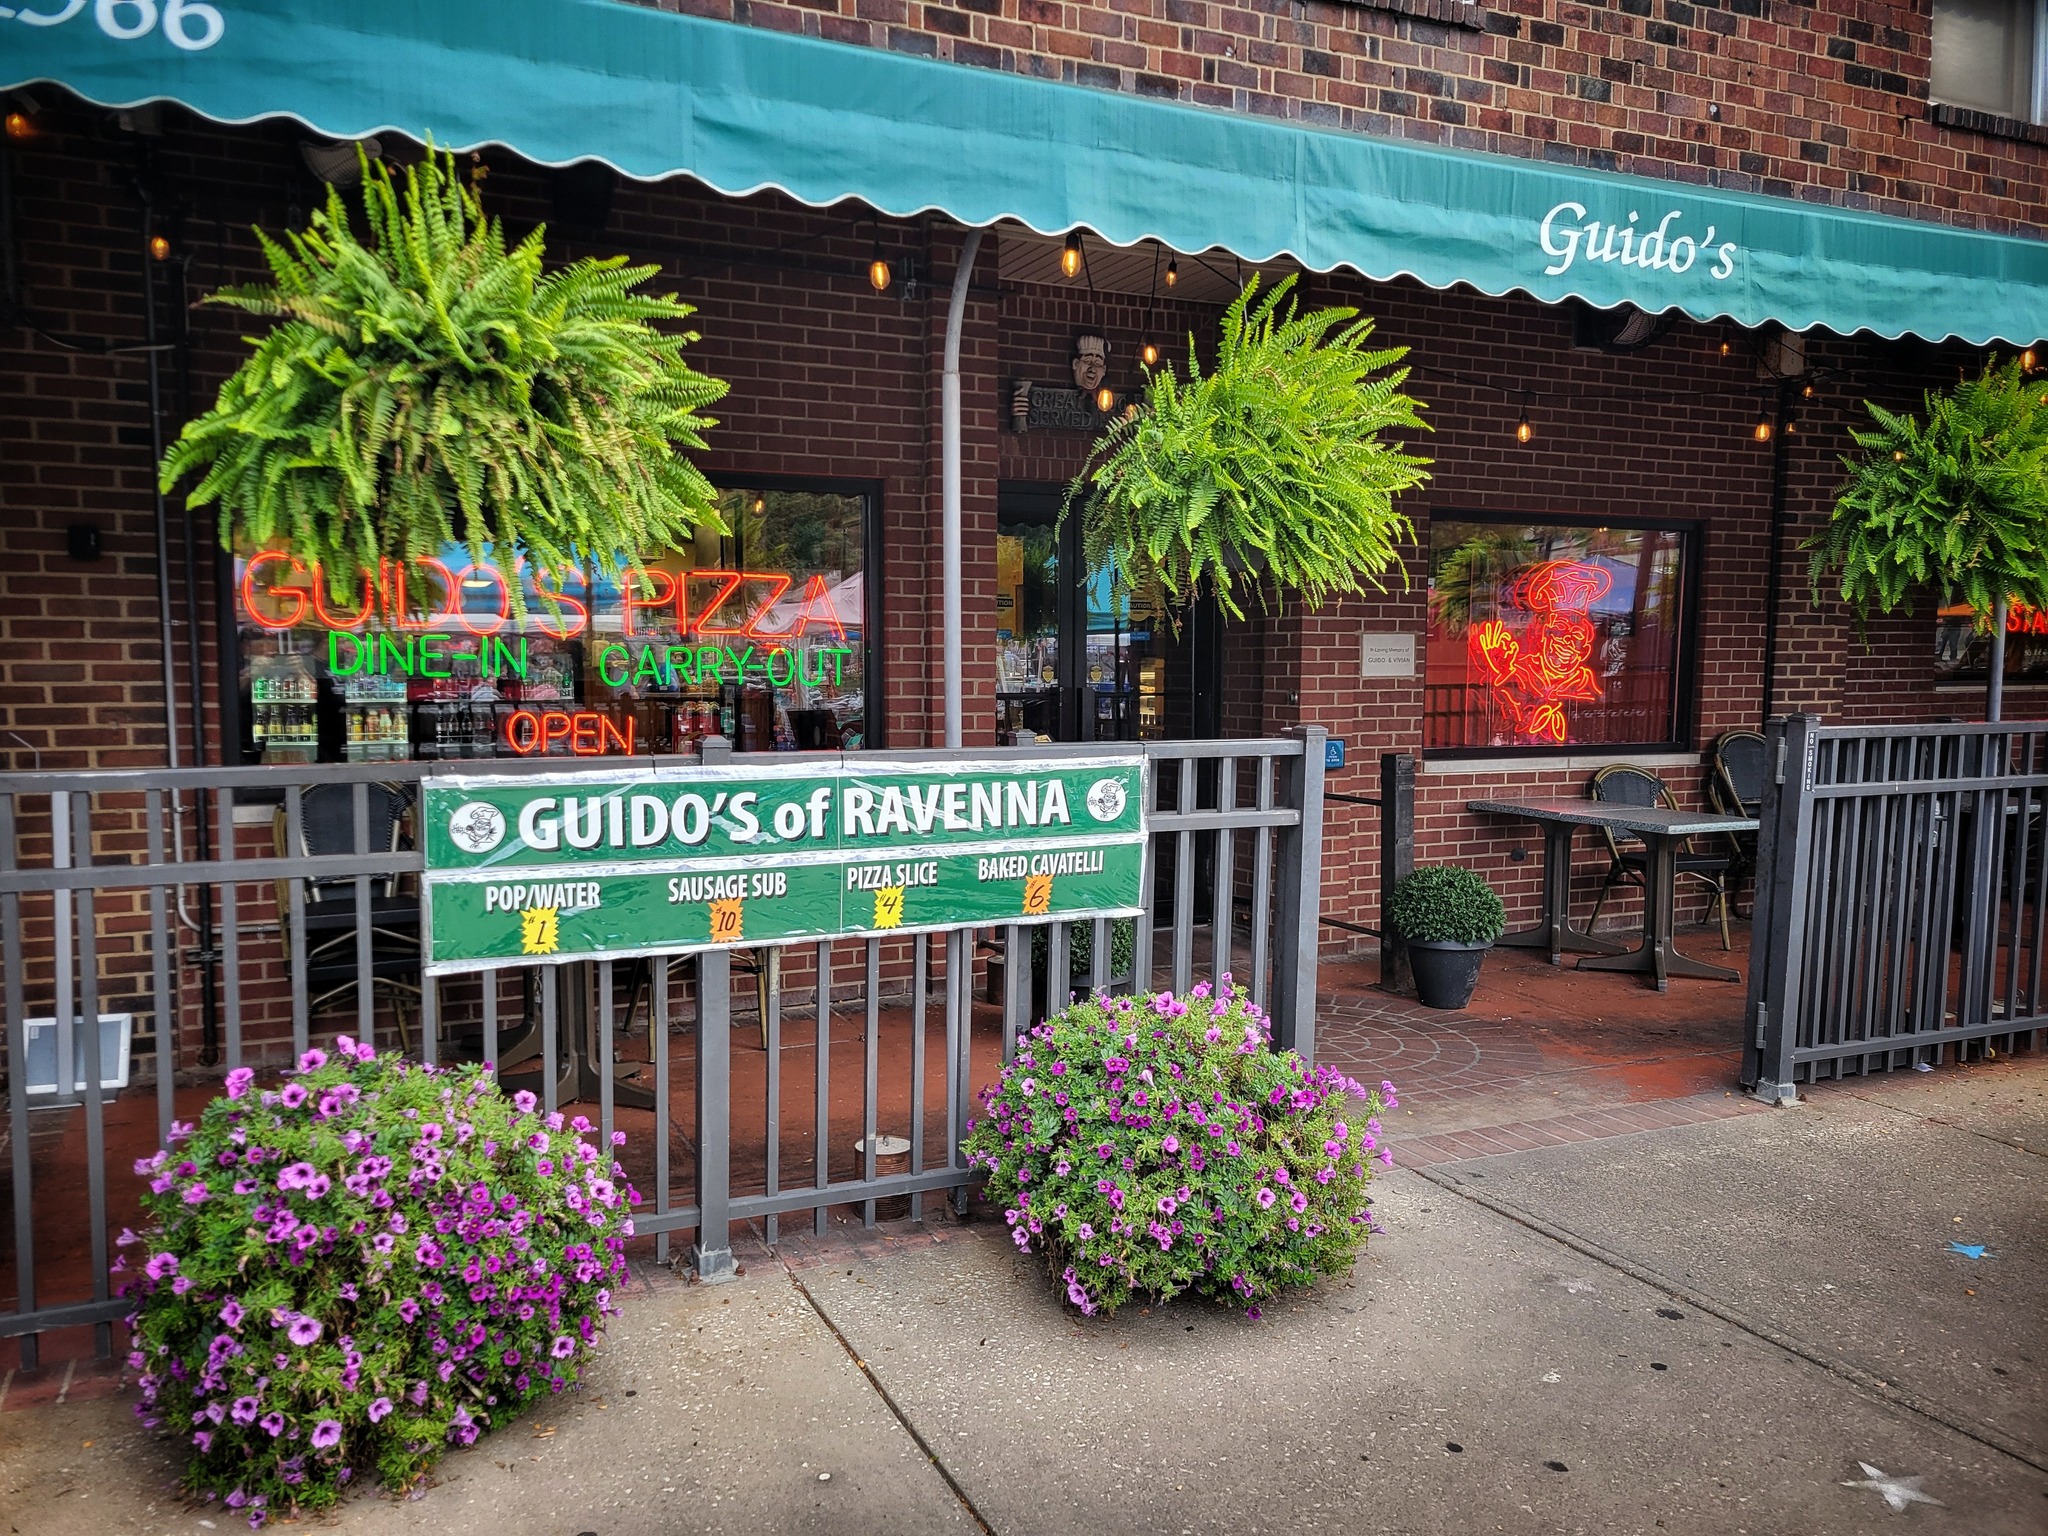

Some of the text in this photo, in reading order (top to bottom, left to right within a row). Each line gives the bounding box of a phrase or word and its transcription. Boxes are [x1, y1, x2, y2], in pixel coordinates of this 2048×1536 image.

[1540, 202, 1737, 280] Guido's
[1029, 408, 1092, 428] SERVED
[622, 568, 848, 641] PIZZA
[328, 630, 852, 687] DINE-IN CARRY-OUT
[506, 711, 635, 756] OPEN
[1806, 749, 1814, 791] SMOKING
[518, 779, 1072, 850] GUIDO'S of RAVENNA
[847, 861, 938, 891] PIZZA SLICE
[978, 850, 1105, 882] BAKED CAVATELLI
[485, 882, 602, 912] POP/WATER
[668, 872, 787, 903] SAUSAGE SUB
